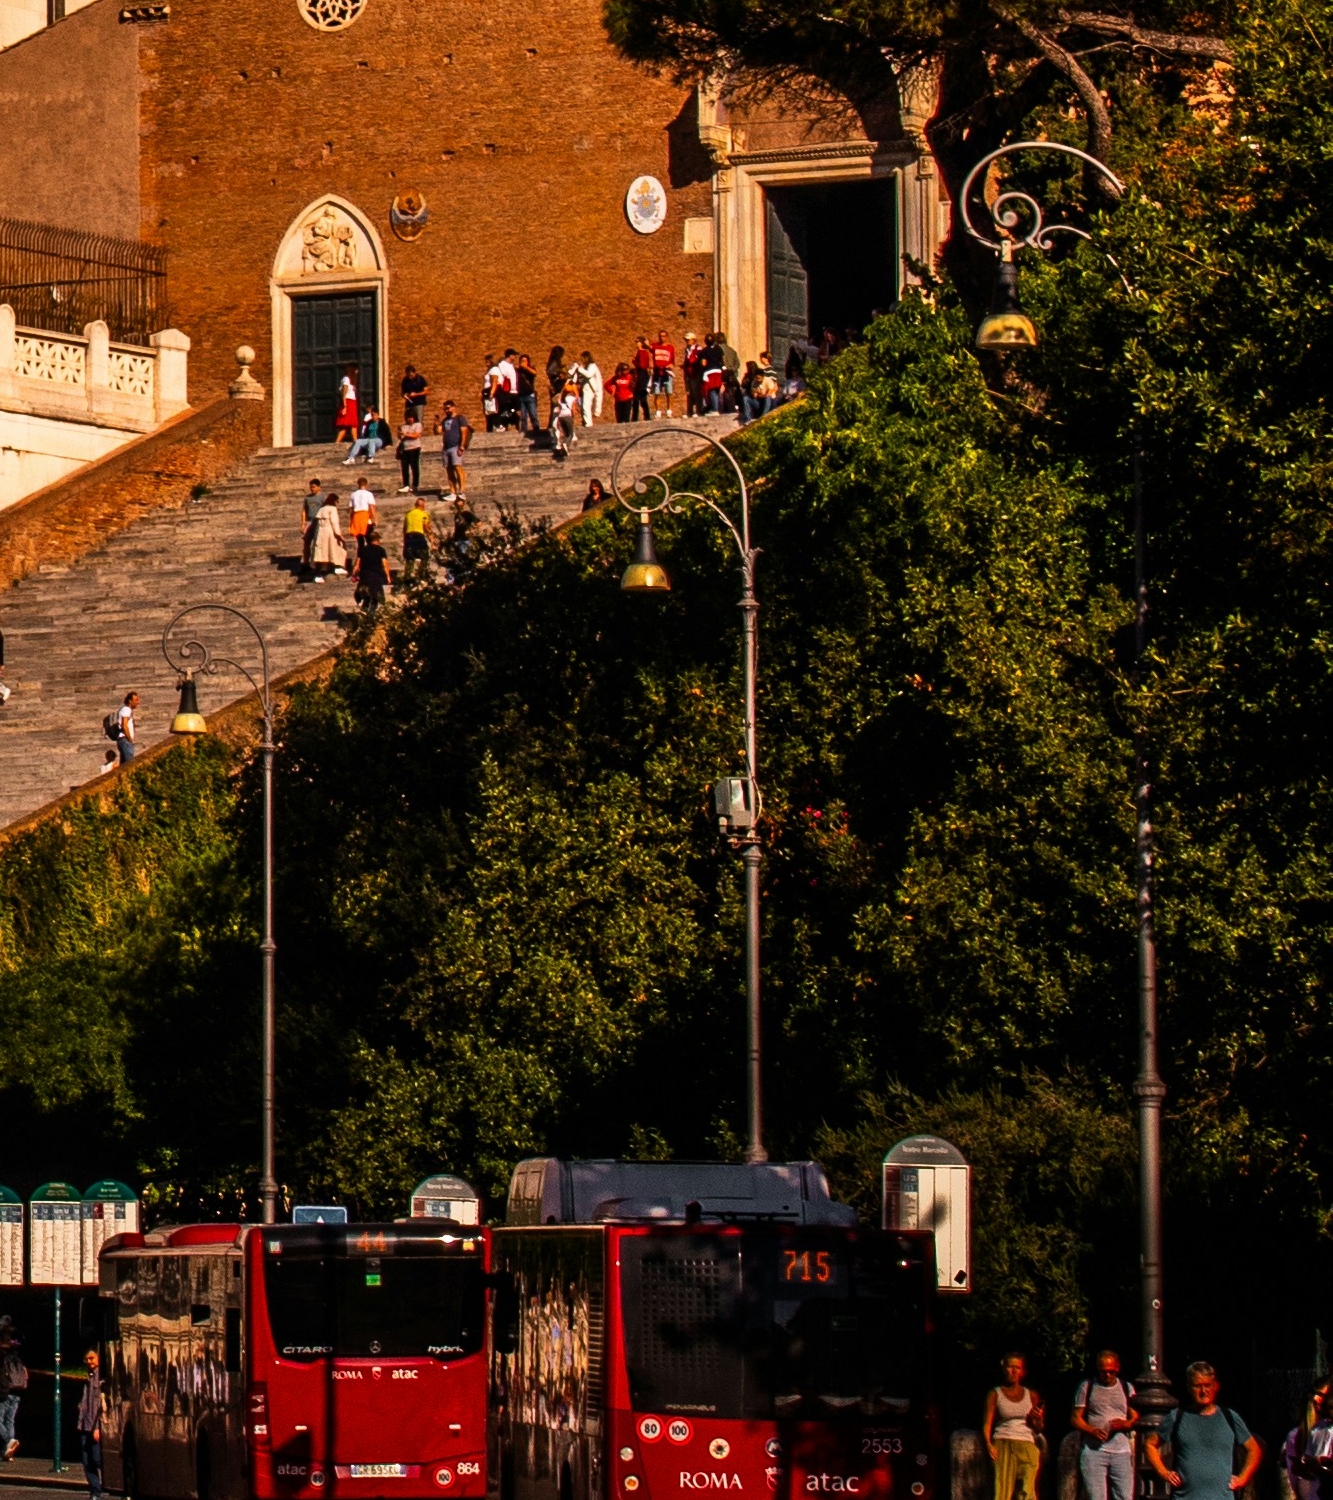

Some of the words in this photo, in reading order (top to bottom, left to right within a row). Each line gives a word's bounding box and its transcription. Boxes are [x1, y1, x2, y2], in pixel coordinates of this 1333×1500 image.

[357, 1231, 385, 1251] 44
[784, 1250, 830, 1282] 715
[283, 1346, 333, 1354] CITARO
[332, 1370, 363, 1380] ROMA
[392, 1369, 418, 1379] atac
[644, 1423, 657, 1434] 80
[671, 1425, 687, 1436] 100
[861, 1438, 903, 1454] 2553
[277, 1464, 307, 1475] atac
[457, 1462, 480, 1475] 864
[438, 1473, 450, 1483] 100
[680, 1472, 743, 1490] ROMA
[806, 1473, 859, 1492] atac
